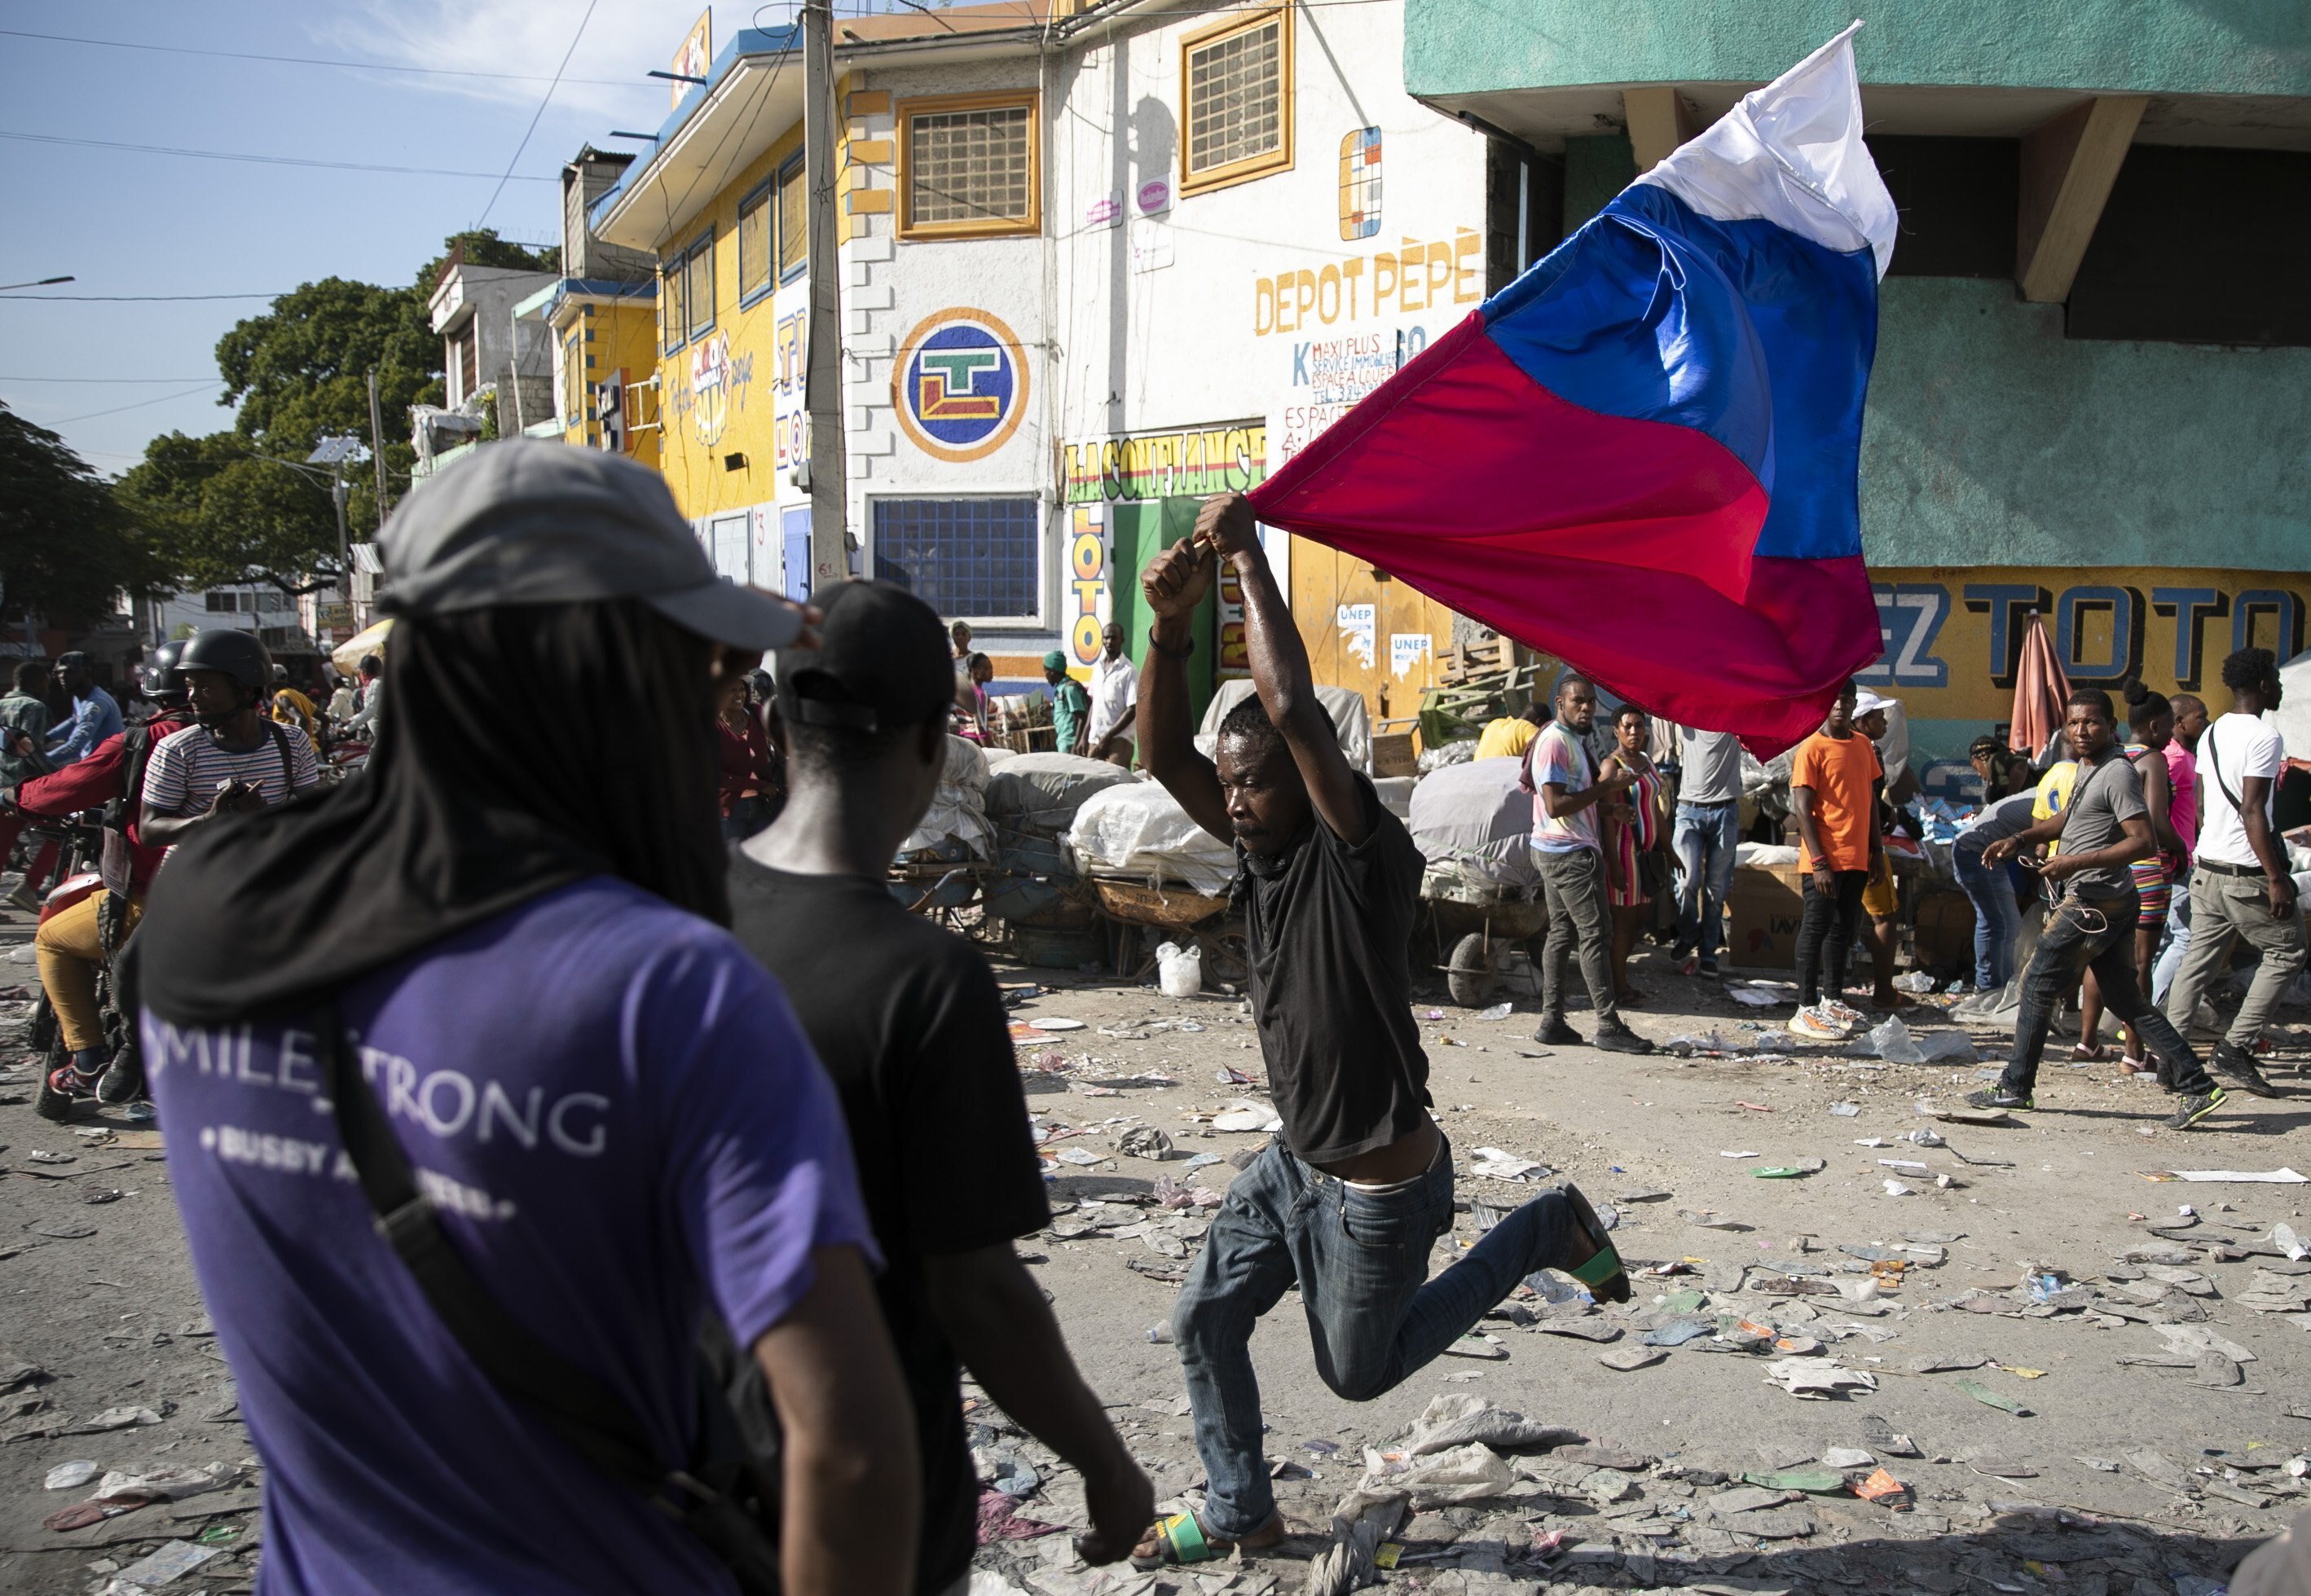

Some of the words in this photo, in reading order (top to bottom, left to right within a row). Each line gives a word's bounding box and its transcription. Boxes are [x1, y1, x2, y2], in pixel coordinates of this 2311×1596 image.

[1255, 256, 1363, 336] DEPOT
[1312, 339, 1342, 360] MAXI
[1346, 333, 1380, 356] PLUS
[1312, 356, 1349, 374] SERVICE
[1312, 372, 1345, 389] ESPACE
[1065, 442, 1103, 503] LA
[1072, 506, 1104, 666] LOTO
[1340, 609, 1371, 620] UNEP
[1394, 639, 1428, 650] UNEP
[312, 1028, 611, 1159] TRONG
[217, 1124, 328, 1175] BUSBY
